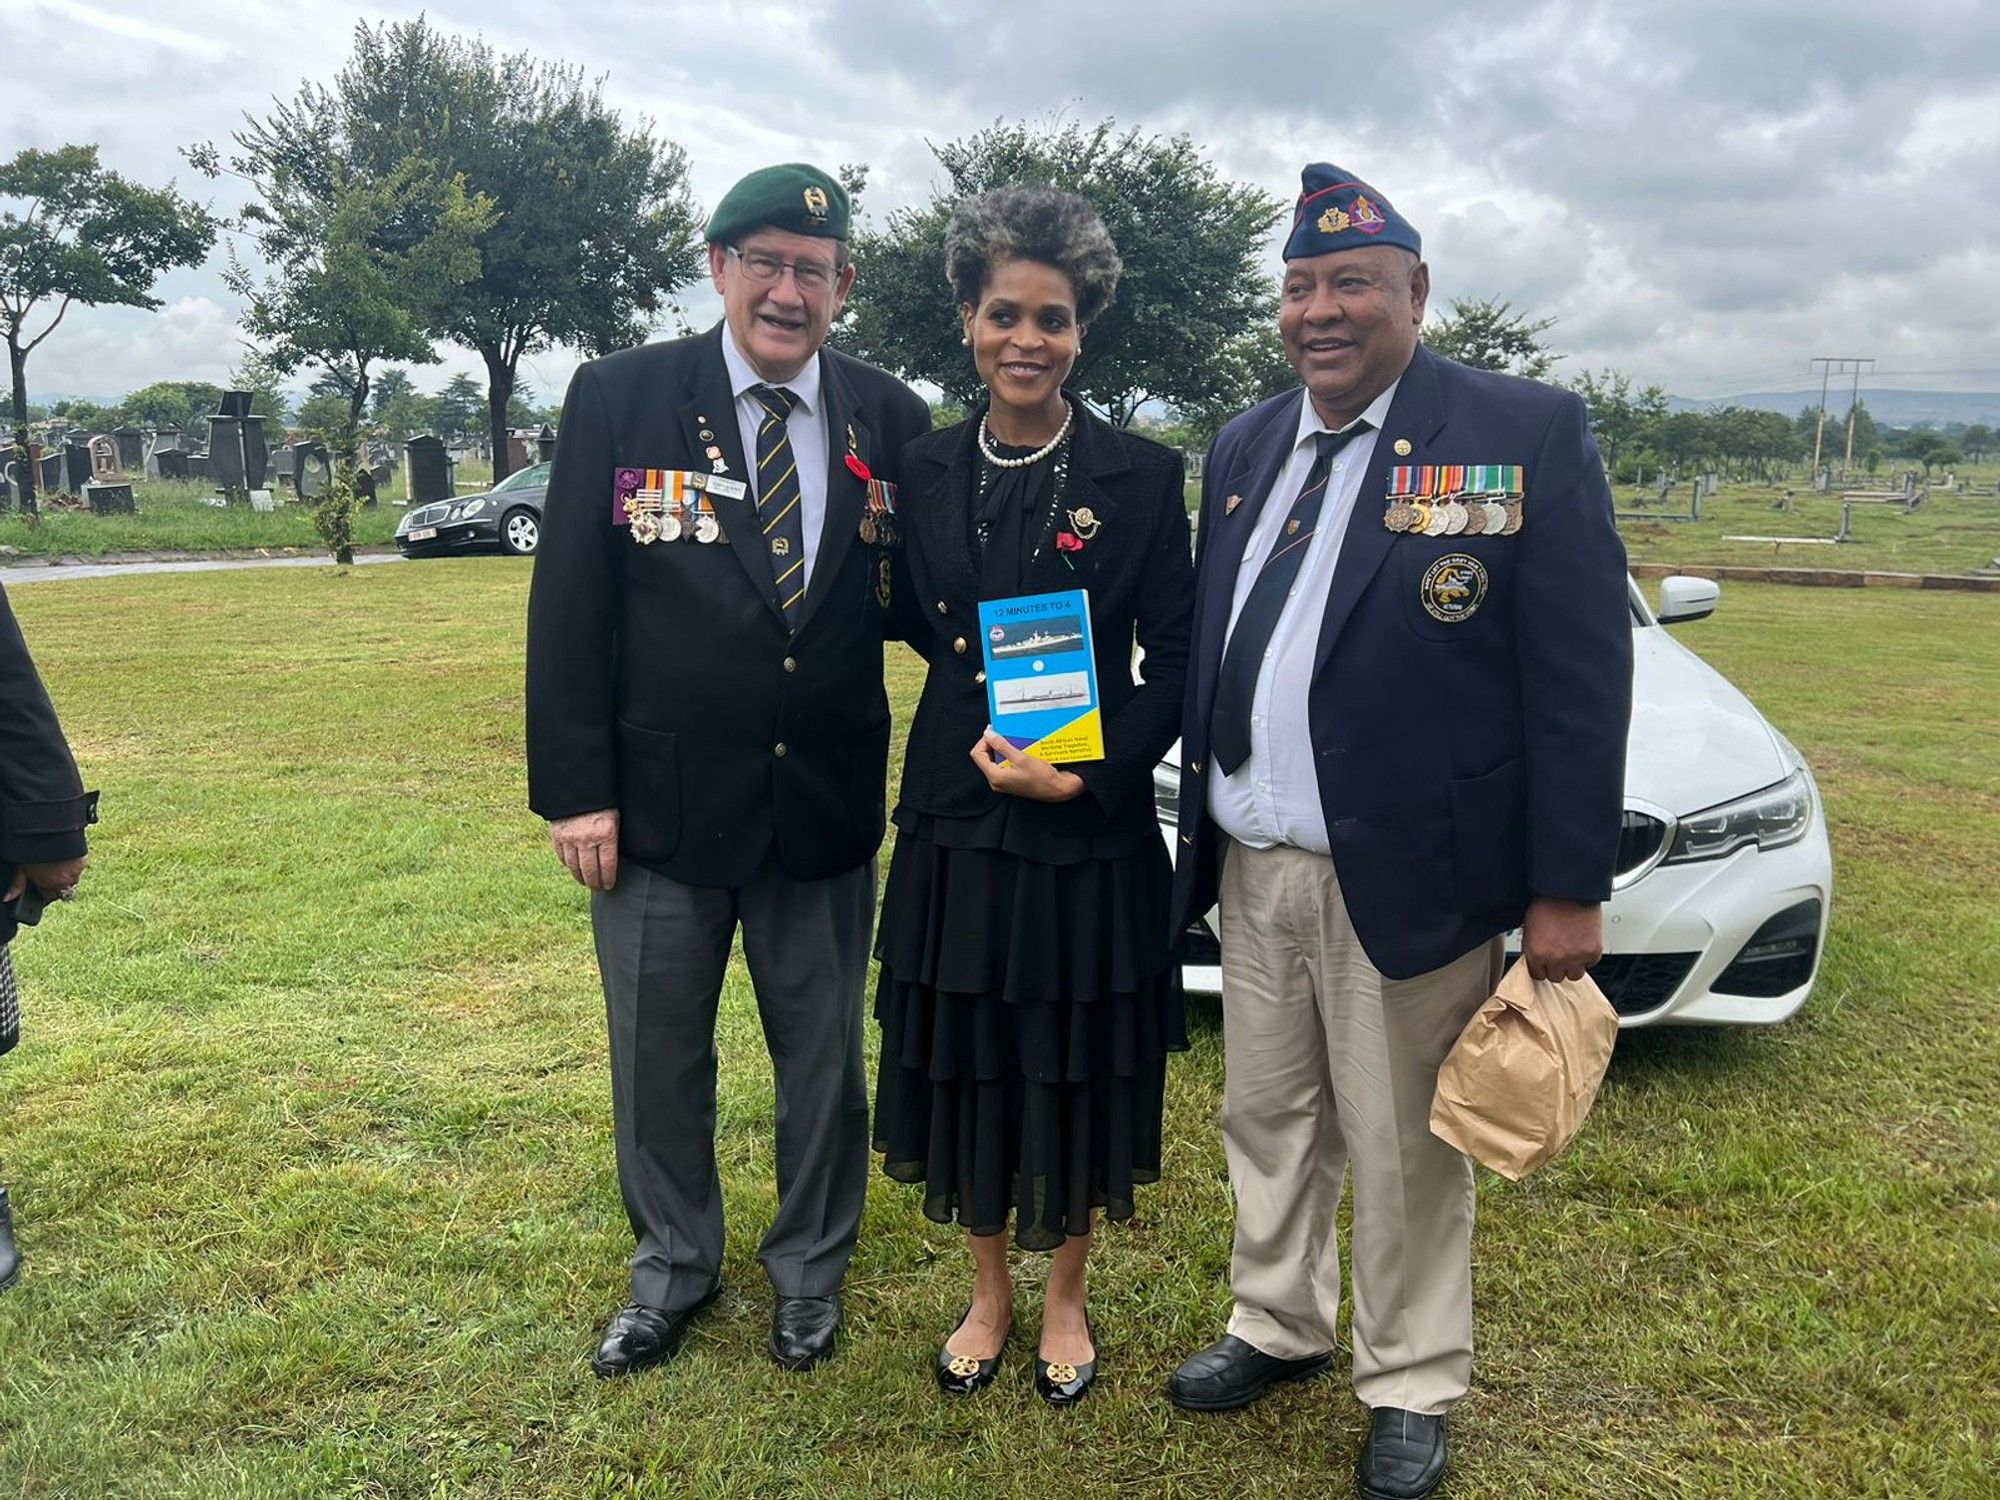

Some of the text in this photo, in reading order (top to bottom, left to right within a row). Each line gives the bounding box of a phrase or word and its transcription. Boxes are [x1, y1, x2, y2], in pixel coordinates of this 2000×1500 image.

[993, 600, 1072, 617] 12 MINUTES TO 4
